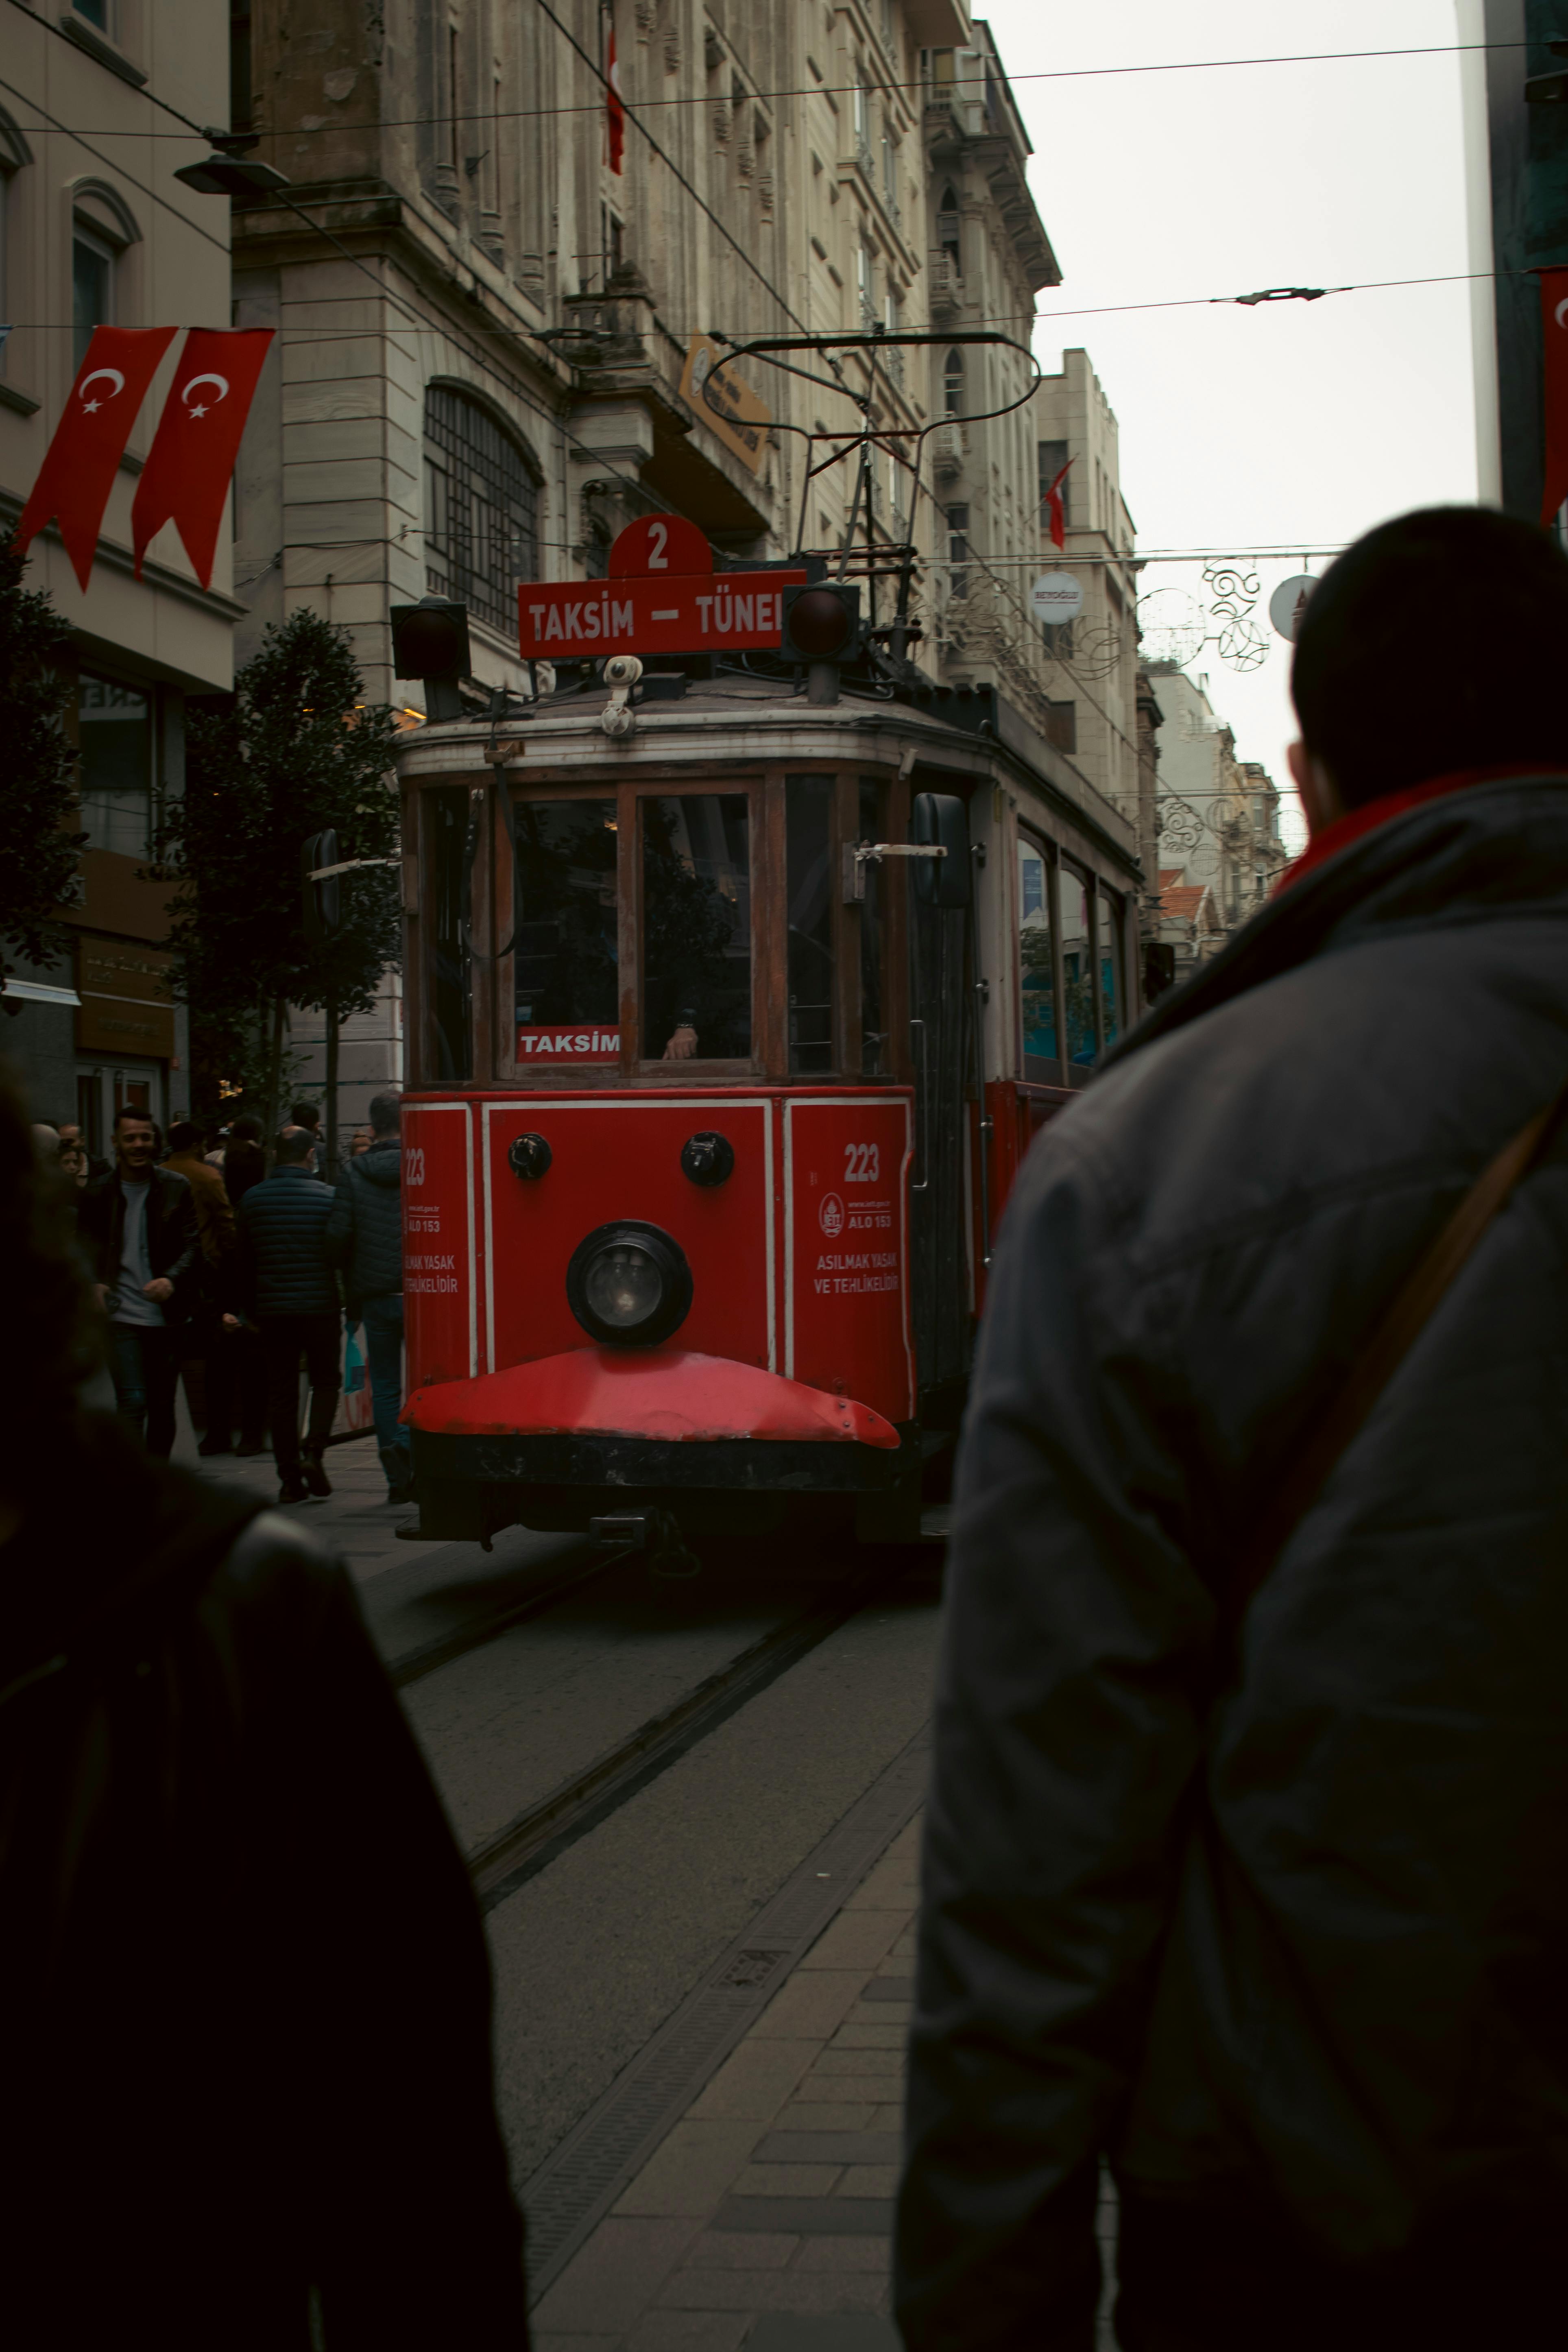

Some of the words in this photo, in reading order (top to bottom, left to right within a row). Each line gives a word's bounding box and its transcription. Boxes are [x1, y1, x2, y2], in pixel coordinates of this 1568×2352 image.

[648, 522, 668, 569] 2
[529, 590, 634, 641] TAKSİM
[521, 1031, 620, 1053] TAKSİM
[844, 1143, 879, 1182] 223
[423, 1220, 440, 1233] 153
[848, 1216, 873, 1228] ALO
[875, 1215, 892, 1228] 153
[423, 1255, 455, 1270] YASAK
[816, 1254, 870, 1270] ASILMAK
[871, 1252, 897, 1268] YASAK
[813, 1279, 831, 1294] VE
